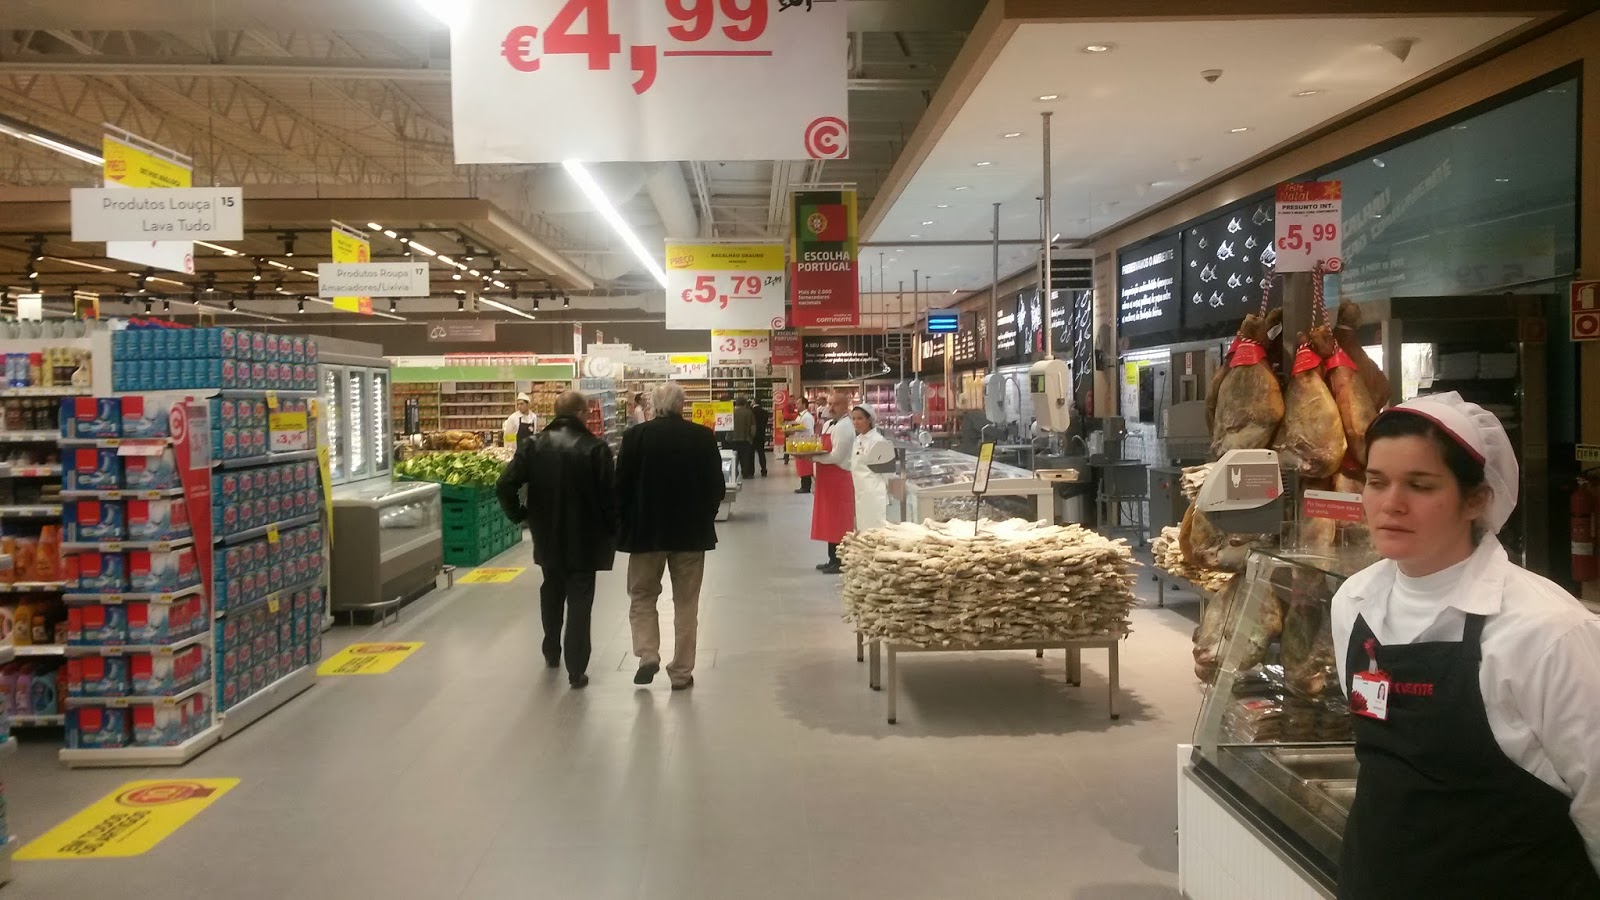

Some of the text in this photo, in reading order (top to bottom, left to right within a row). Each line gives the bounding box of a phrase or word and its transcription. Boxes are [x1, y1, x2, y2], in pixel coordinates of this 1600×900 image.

[1279, 191, 1310, 200] Natal
[102, 196, 210, 213] Produtos Louça
[221, 196, 235, 207] 15
[142, 218, 211, 232] Lava Tudo
[1278, 223, 1337, 256] €5,99
[670, 255, 695, 265] PREÇO
[804, 251, 850, 262] ESCOLHA
[415, 268, 424, 276] 17
[797, 261, 851, 272] PORTUGAL
[337, 269, 409, 279] Produtos Roupa
[681, 275, 762, 310] €5,79
